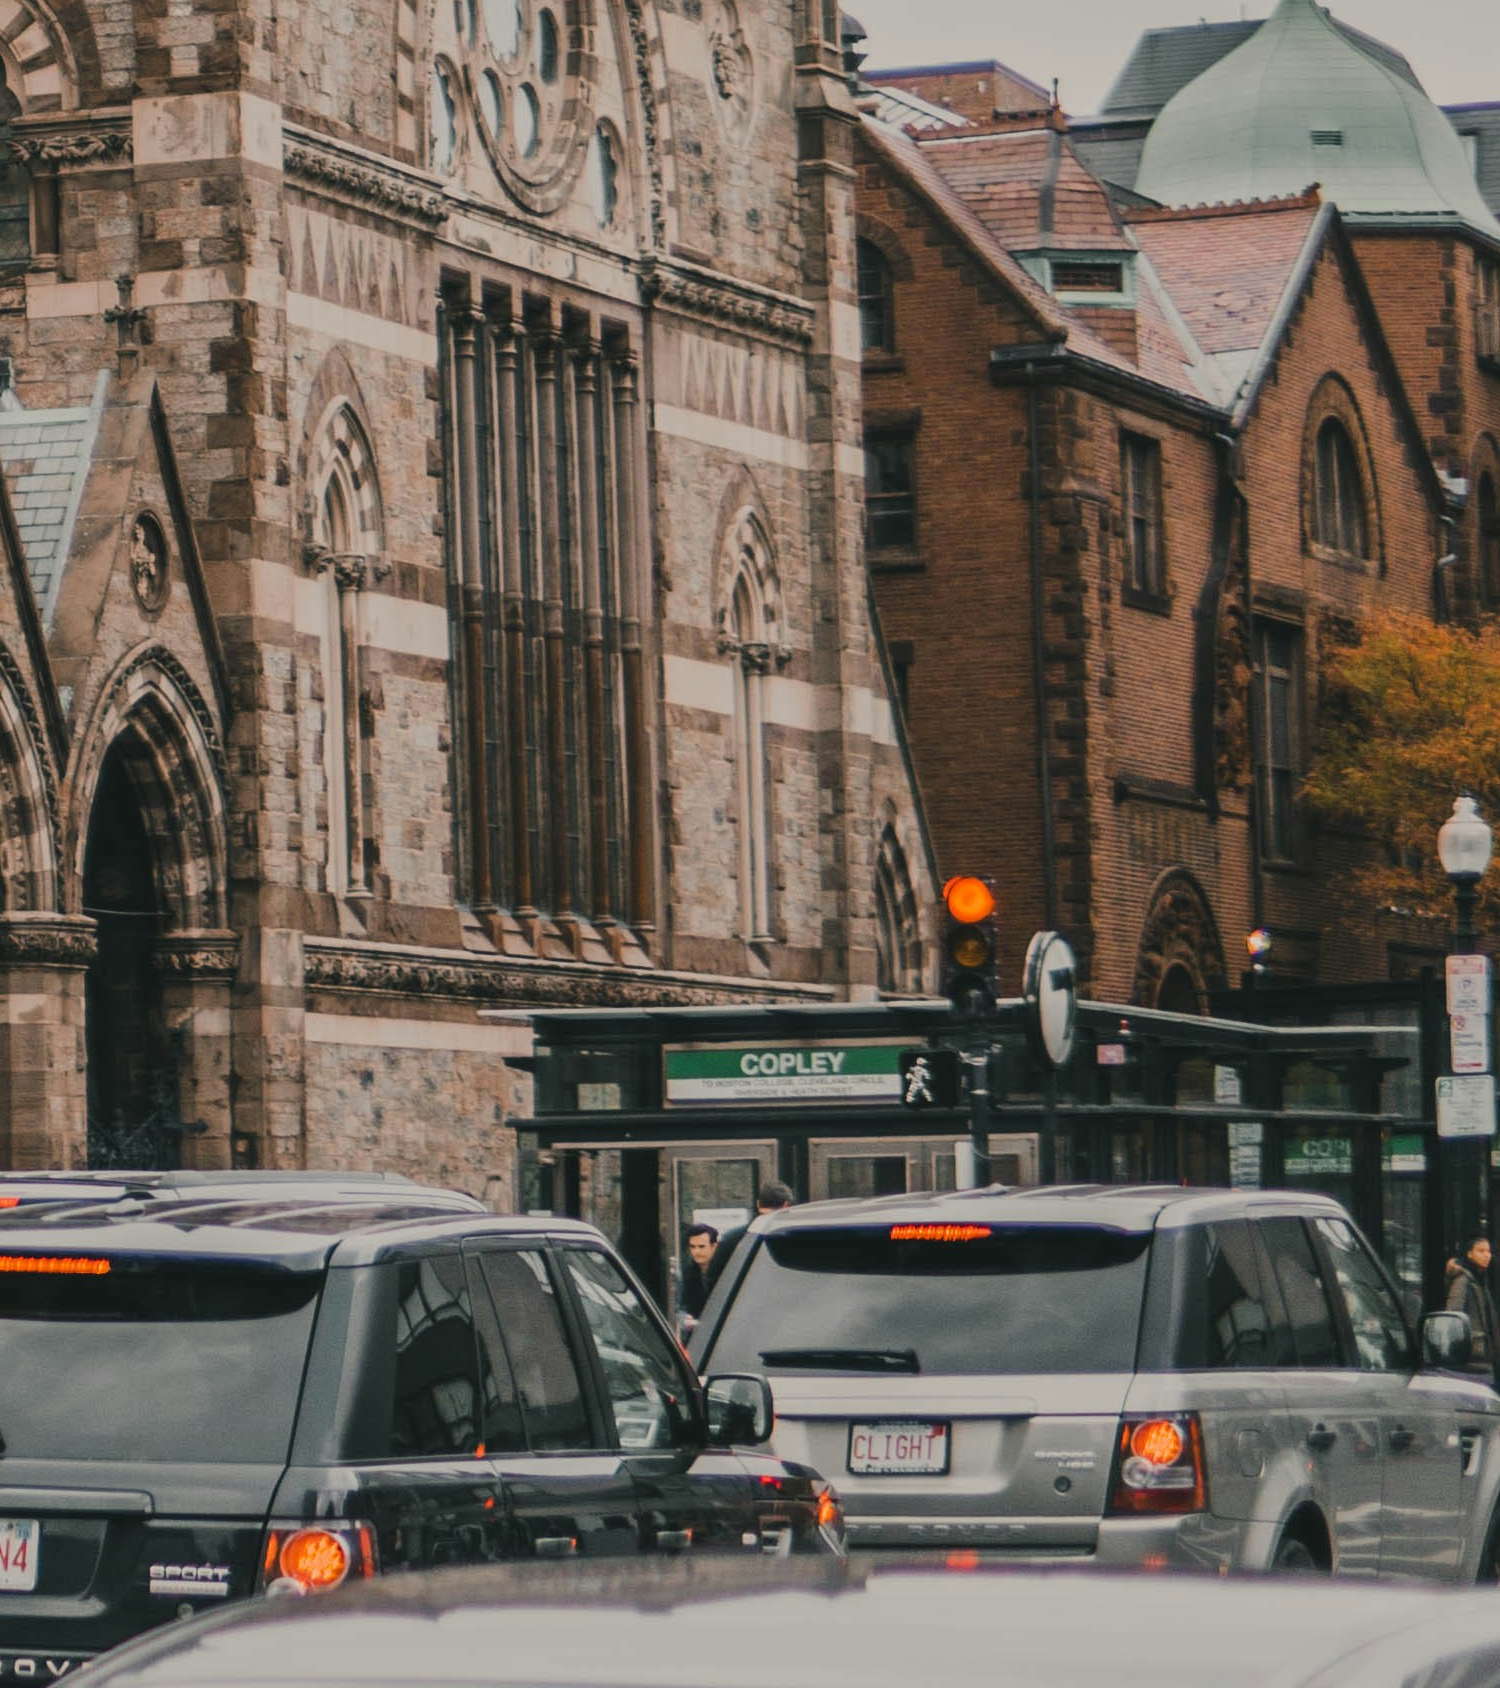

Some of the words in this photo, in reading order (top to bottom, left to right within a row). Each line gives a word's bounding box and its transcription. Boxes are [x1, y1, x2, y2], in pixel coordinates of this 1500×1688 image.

[740, 1052, 846, 1076] COPLEY
[853, 1434, 937, 1461] CLIGHT
[149, 1565, 230, 1581] SPORT
